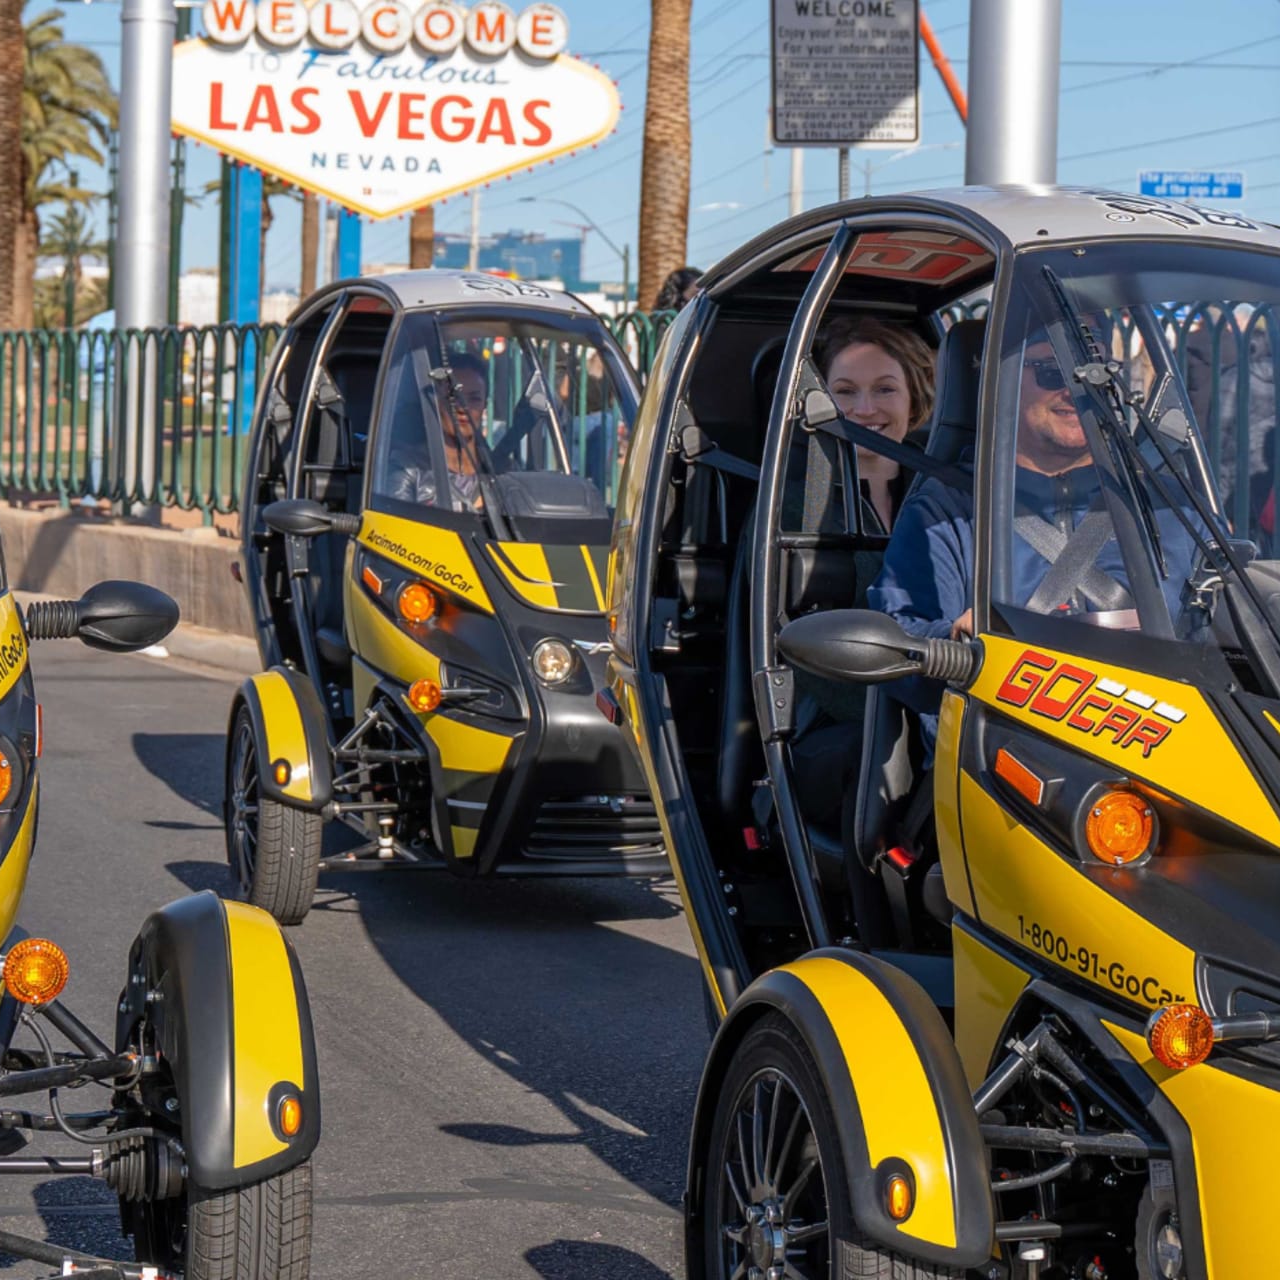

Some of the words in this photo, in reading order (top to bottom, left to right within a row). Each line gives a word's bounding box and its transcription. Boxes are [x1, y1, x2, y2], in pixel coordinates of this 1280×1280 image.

[212, 1, 553, 46] WELCOME
[795, 1, 896, 18] WELCOME
[783, 42, 802, 54] For
[807, 44, 833, 56] your
[249, 53, 280, 73] TO
[297, 50, 510, 85] Fabulous
[208, 82, 321, 135] LAS
[347, 89, 553, 147] VEGAS
[311, 152, 442, 174] NEVADA
[366, 529, 474, 593] Arcimoto.com/GoCar
